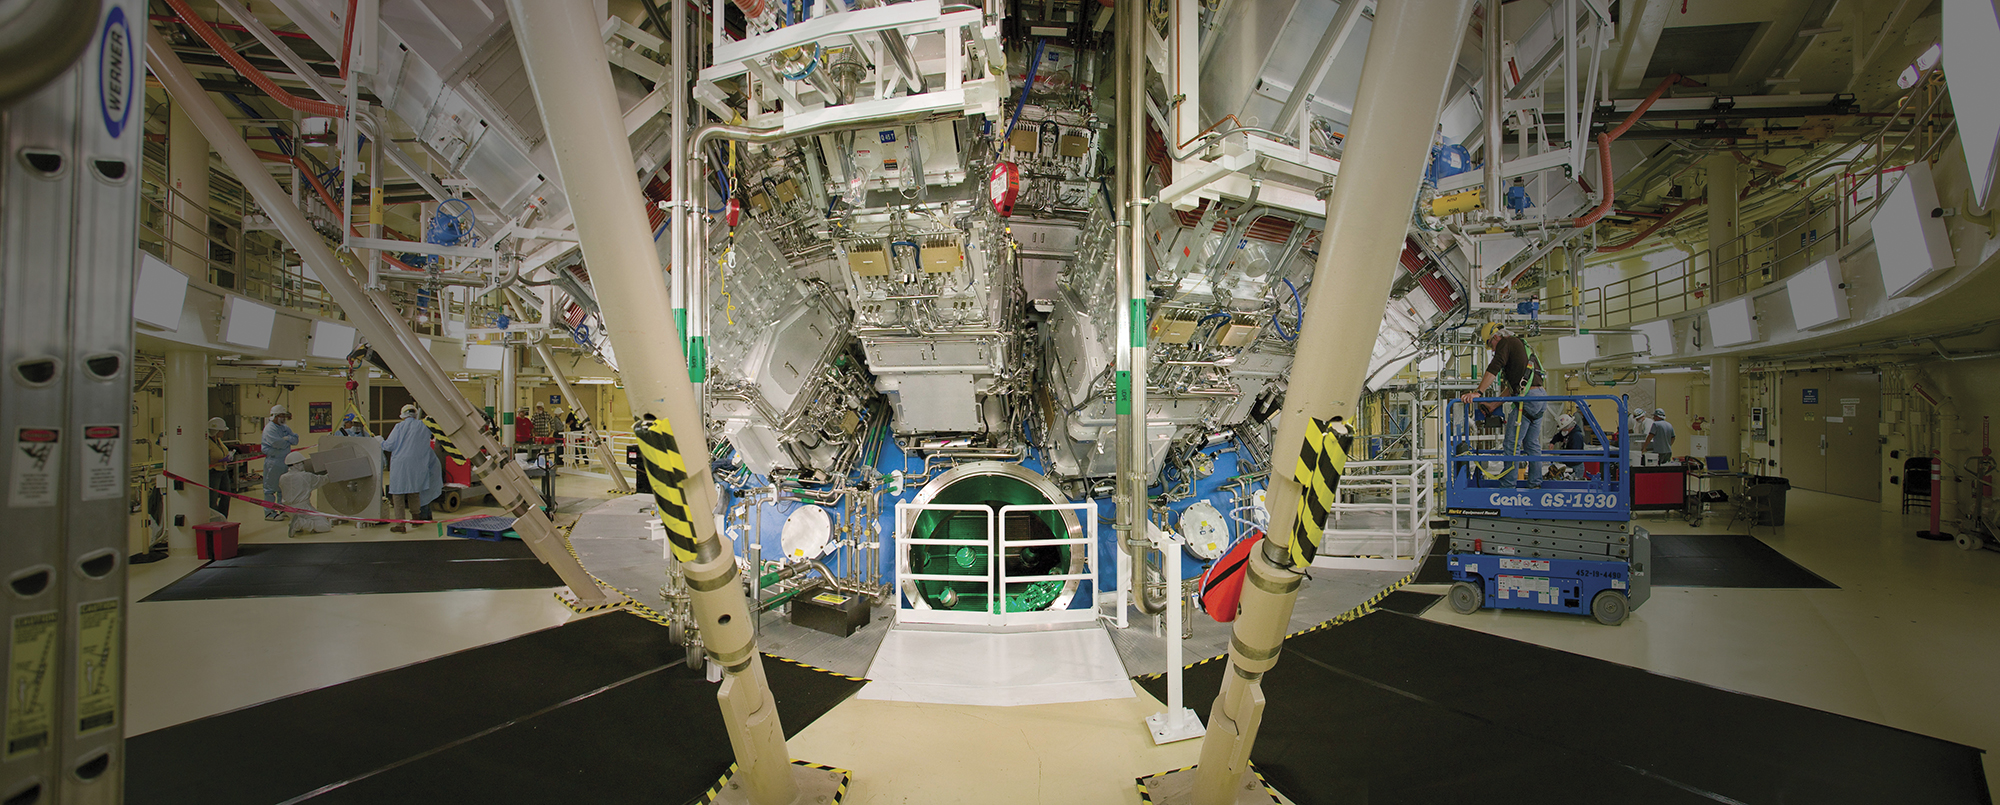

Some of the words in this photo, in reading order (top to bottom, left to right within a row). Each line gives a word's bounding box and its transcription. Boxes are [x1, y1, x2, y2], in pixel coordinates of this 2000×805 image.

[109, 30, 123, 111] WERNER
[1489, 492, 1532, 507] Genie
[1540, 493, 1618, 509] GS-1930
